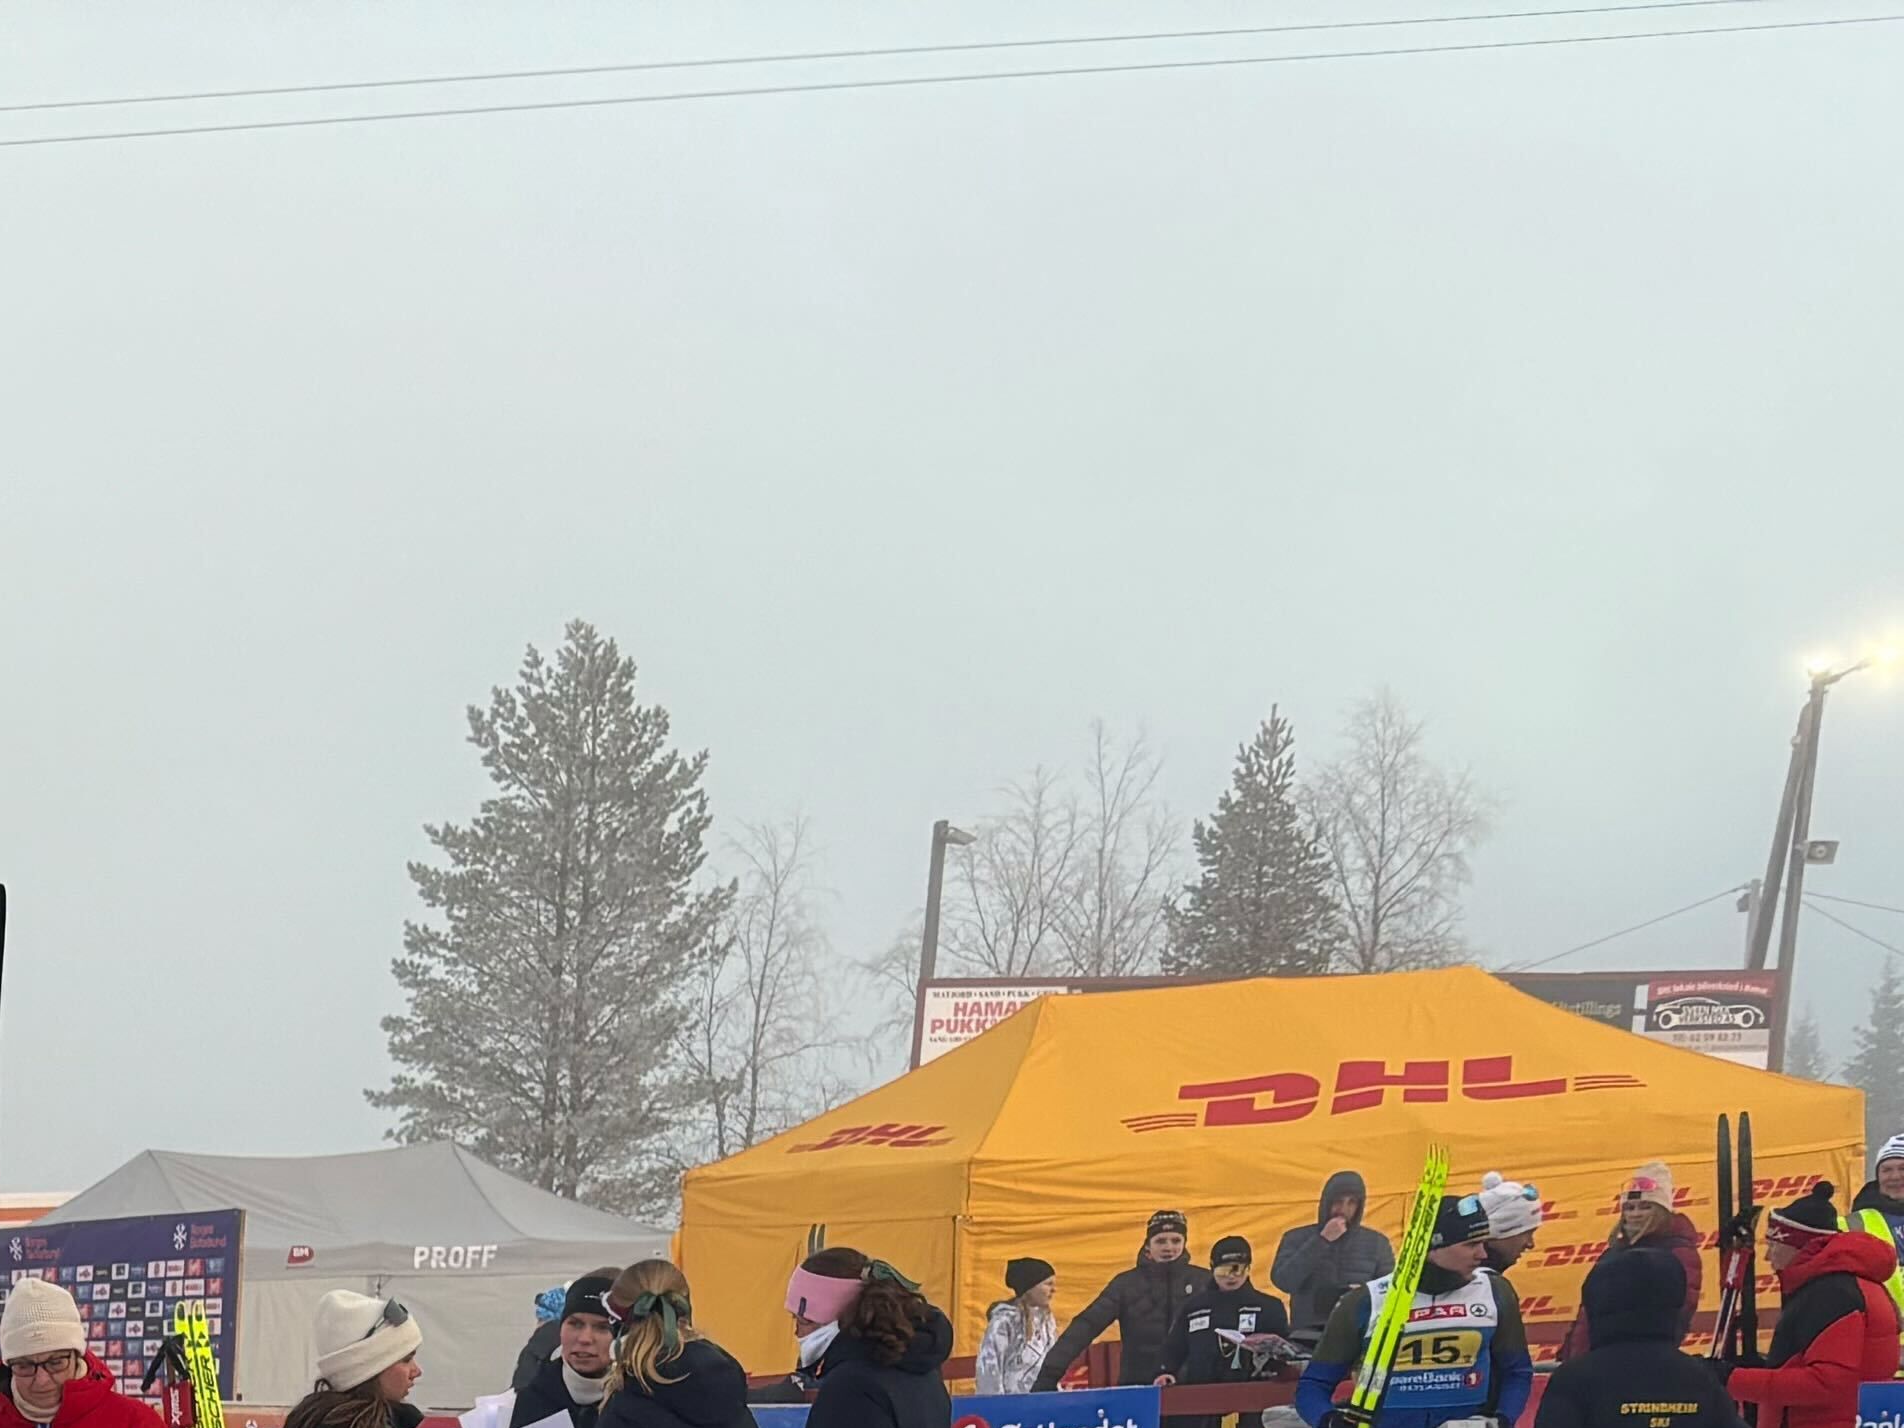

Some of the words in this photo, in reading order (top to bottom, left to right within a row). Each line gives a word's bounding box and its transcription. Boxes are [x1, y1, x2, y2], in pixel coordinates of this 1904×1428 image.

[954, 1002, 1030, 1017] HAMA
[1177, 1055, 1567, 1127] DHL
[810, 1123, 949, 1151] DHL
[413, 1244, 497, 1270] PROFF
[1543, 1241, 1609, 1267] DH
[1414, 1307, 1465, 1319] PAR
[1402, 1337, 1460, 1364] 15
